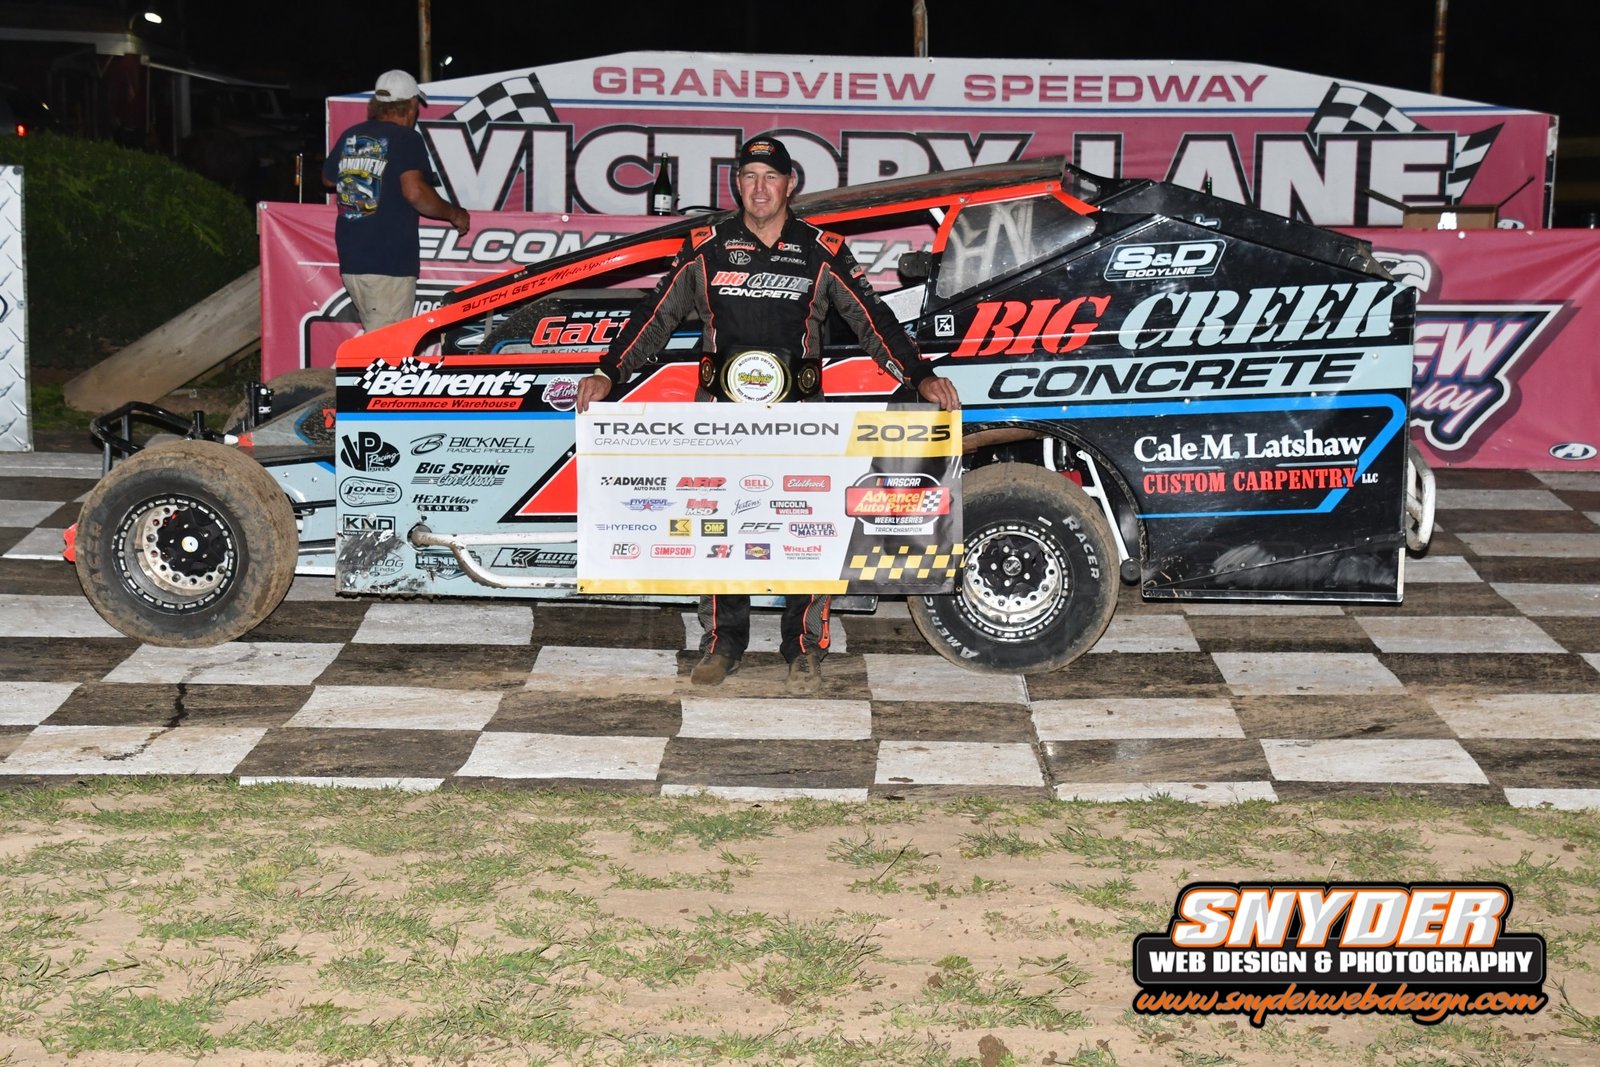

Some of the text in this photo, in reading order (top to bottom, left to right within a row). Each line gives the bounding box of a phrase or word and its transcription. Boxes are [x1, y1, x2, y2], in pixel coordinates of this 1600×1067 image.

[593, 65, 1267, 103] GRANDVIEW SPEEDWAY
[417, 228, 646, 264] ELCOM
[1113, 243, 1218, 271] S&D
[1124, 266, 1198, 278] BODYLINE
[711, 270, 814, 293] BIG CREEK
[461, 290, 508, 313] BUTCH
[511, 276, 547, 295] GETZ
[718, 286, 802, 301] CONCRETE
[951, 295, 1112, 358] BIG
[1117, 280, 1413, 351] CREEK
[367, 369, 537, 397] Behrent's
[987, 352, 1366, 401] CONCRETE
[371, 399, 518, 409] Performance Warehouse
[594, 422, 839, 435] TRACK CHAMPION
[856, 424, 951, 441] 2025
[449, 436, 536, 448] BICKNELL
[594, 438, 743, 446] GRANDVIEW SPEEDWAY
[1133, 429, 1367, 462] Cale M. Latshaw
[341, 432, 382, 472] VP
[414, 462, 510, 475] BIG SPRING
[437, 474, 497, 488] Car Wash
[613, 476, 668, 486] ADVANCE
[676, 476, 727, 487] ARP
[744, 479, 769, 487] BELL
[787, 478, 826, 489] Edelbrock
[886, 477, 922, 487] NASCAR
[1143, 468, 1379, 495] CUSTOM CARPENTRY LLC
[344, 485, 396, 495] JONES
[860, 490, 920, 503] Advance
[412, 494, 449, 504] HEAT
[685, 508, 715, 516] MSD
[853, 503, 918, 513] Auto Parts
[345, 517, 393, 530] KND
[740, 522, 783, 530] PFC
[874, 516, 924, 524] WEEKLY SERIES
[704, 524, 725, 532] OMP
[790, 523, 833, 532] QUARTER
[654, 547, 692, 556] SIMPSON
[783, 544, 822, 553] WHELEN
[1062, 514, 1100, 580] RACER
[924, 596, 981, 659] AMERIC
